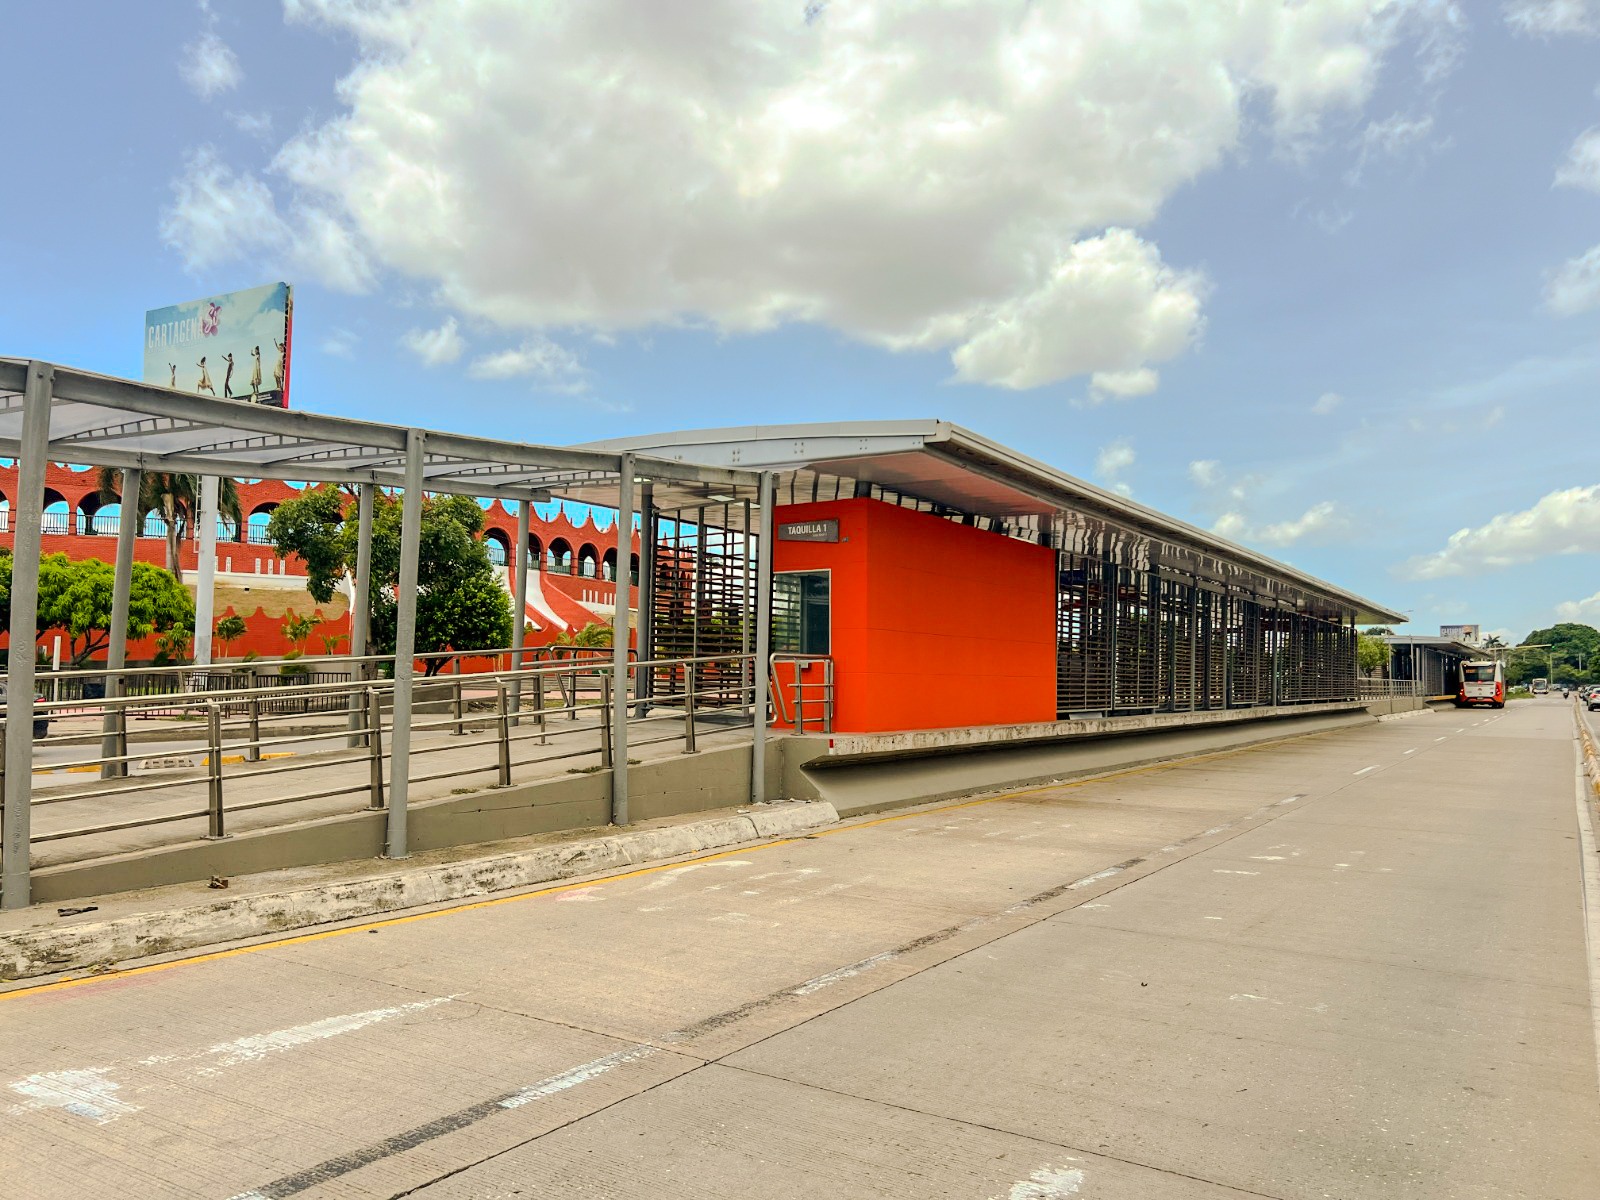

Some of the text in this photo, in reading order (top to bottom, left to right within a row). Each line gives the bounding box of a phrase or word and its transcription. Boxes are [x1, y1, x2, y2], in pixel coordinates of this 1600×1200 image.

[148, 317, 203, 349] CARTAGENA
[788, 523, 827, 535] TAQUILLA 1
